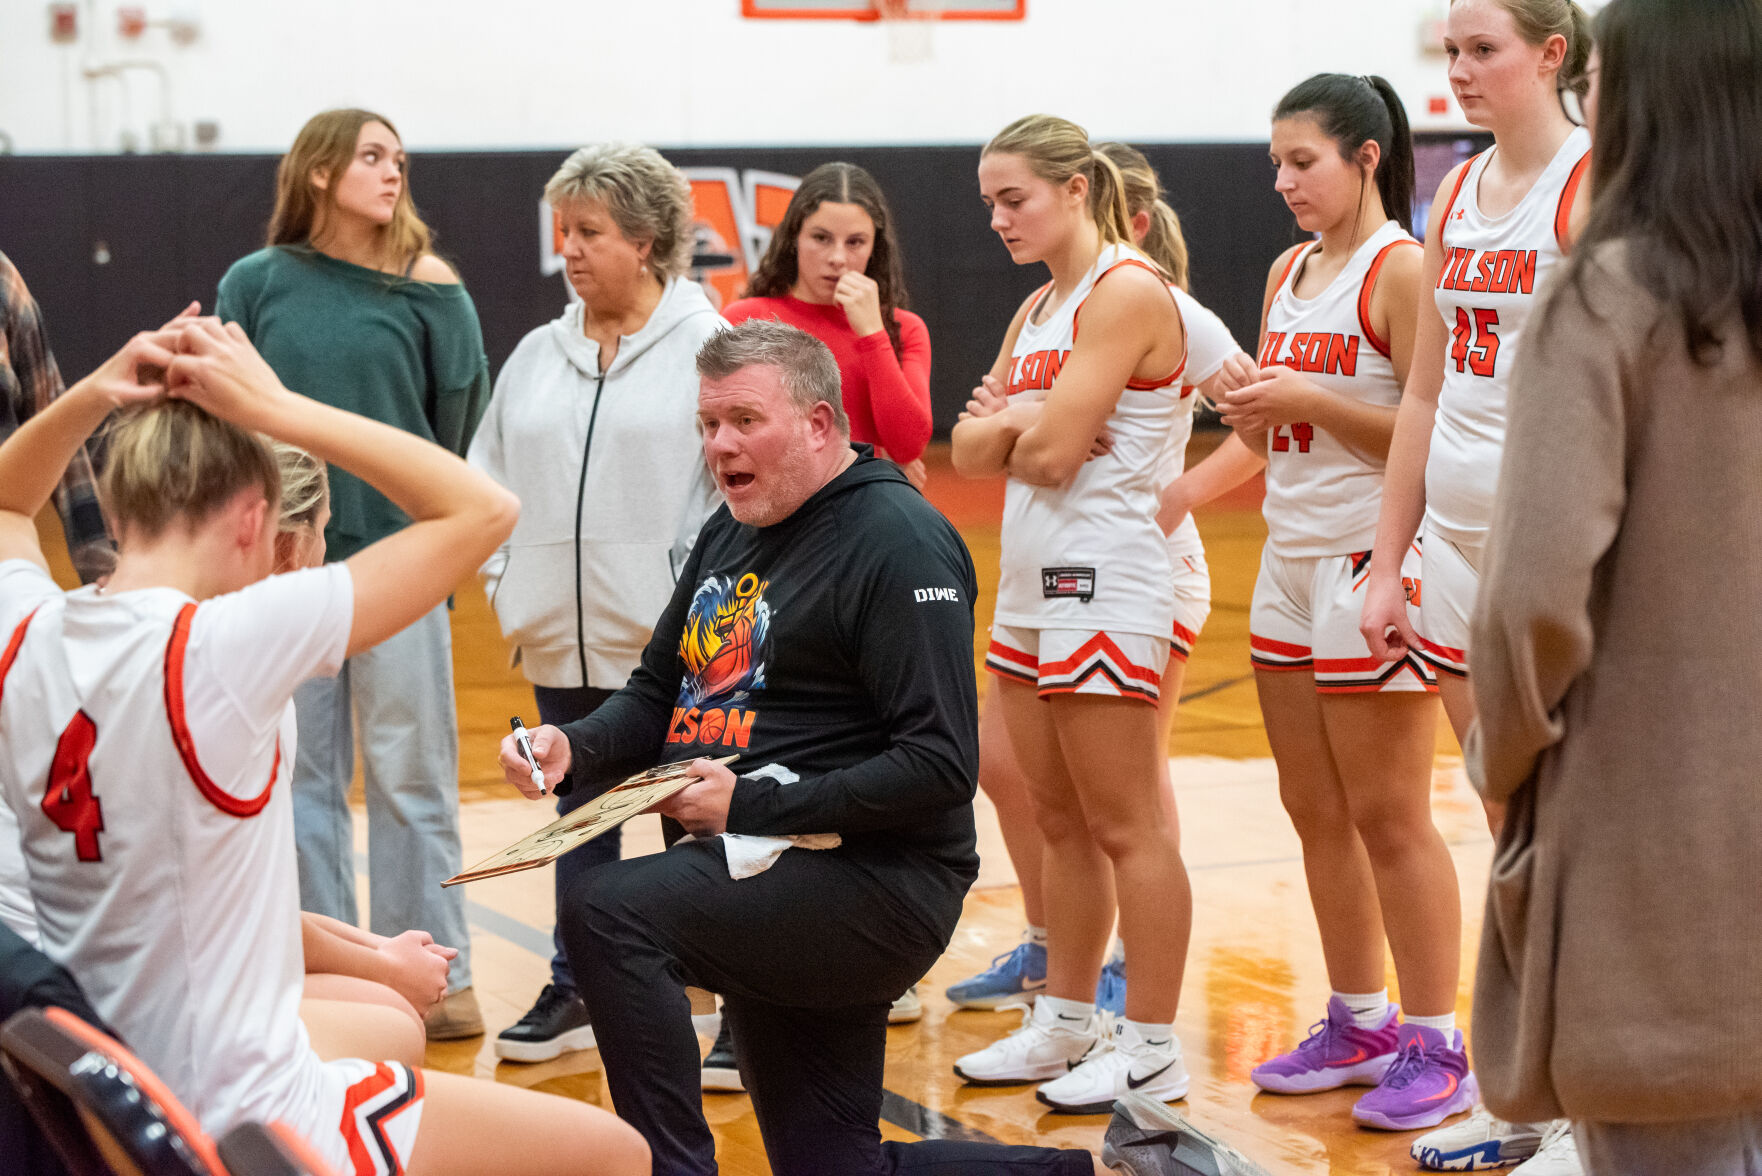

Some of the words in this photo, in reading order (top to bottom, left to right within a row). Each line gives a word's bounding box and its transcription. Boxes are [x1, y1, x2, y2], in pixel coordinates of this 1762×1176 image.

[1436, 246, 1538, 294] ILSON
[1260, 331, 1360, 377] ILSON
[1451, 306, 1500, 378] 45
[1006, 349, 1072, 396] LSON
[913, 587, 959, 603] DIWE
[666, 706, 757, 749] LSON
[40, 708, 105, 863] 4
